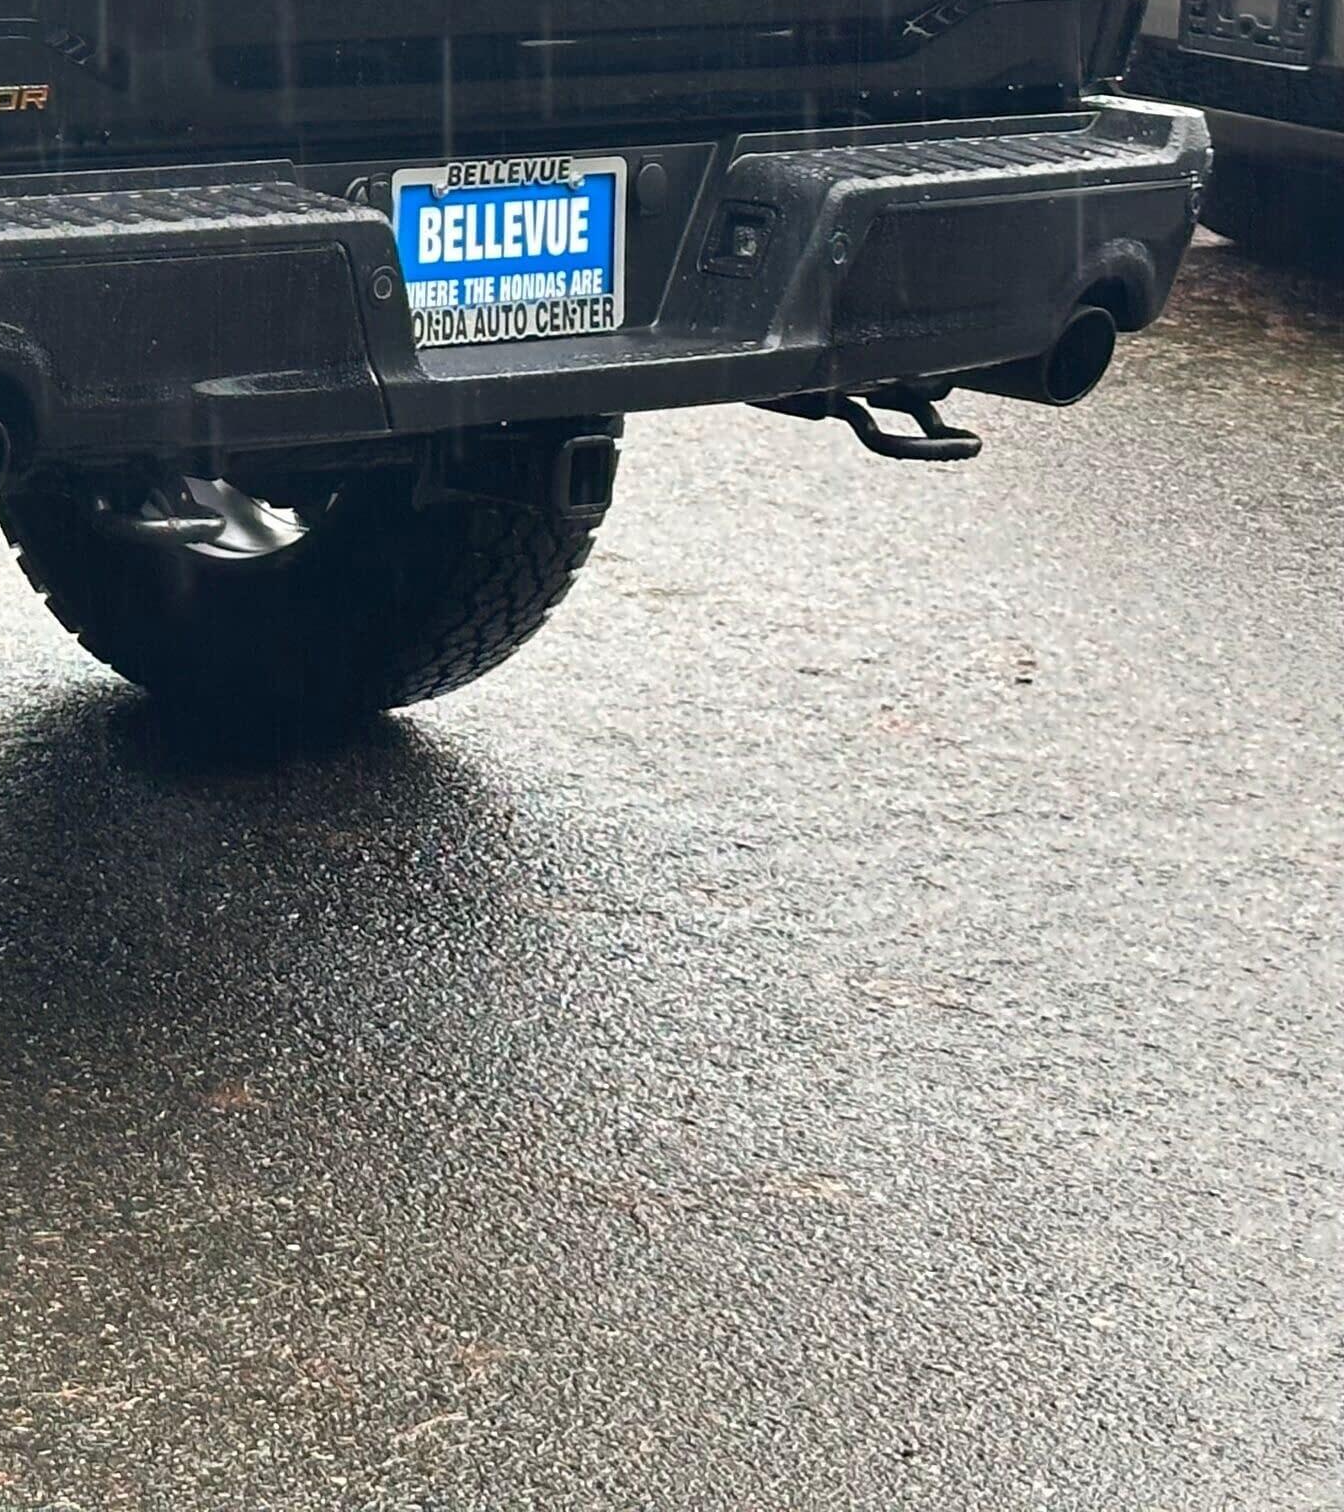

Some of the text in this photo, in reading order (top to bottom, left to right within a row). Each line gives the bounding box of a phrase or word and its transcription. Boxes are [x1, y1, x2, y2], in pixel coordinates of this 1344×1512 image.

[447, 158, 572, 187] BELLEVUE
[418, 196, 590, 265] BELLEVUE
[463, 276, 496, 306] THE
[499, 270, 567, 302] HONDAS
[569, 267, 604, 296] ARE
[412, 296, 615, 344] ONDA AUTO CENTER
